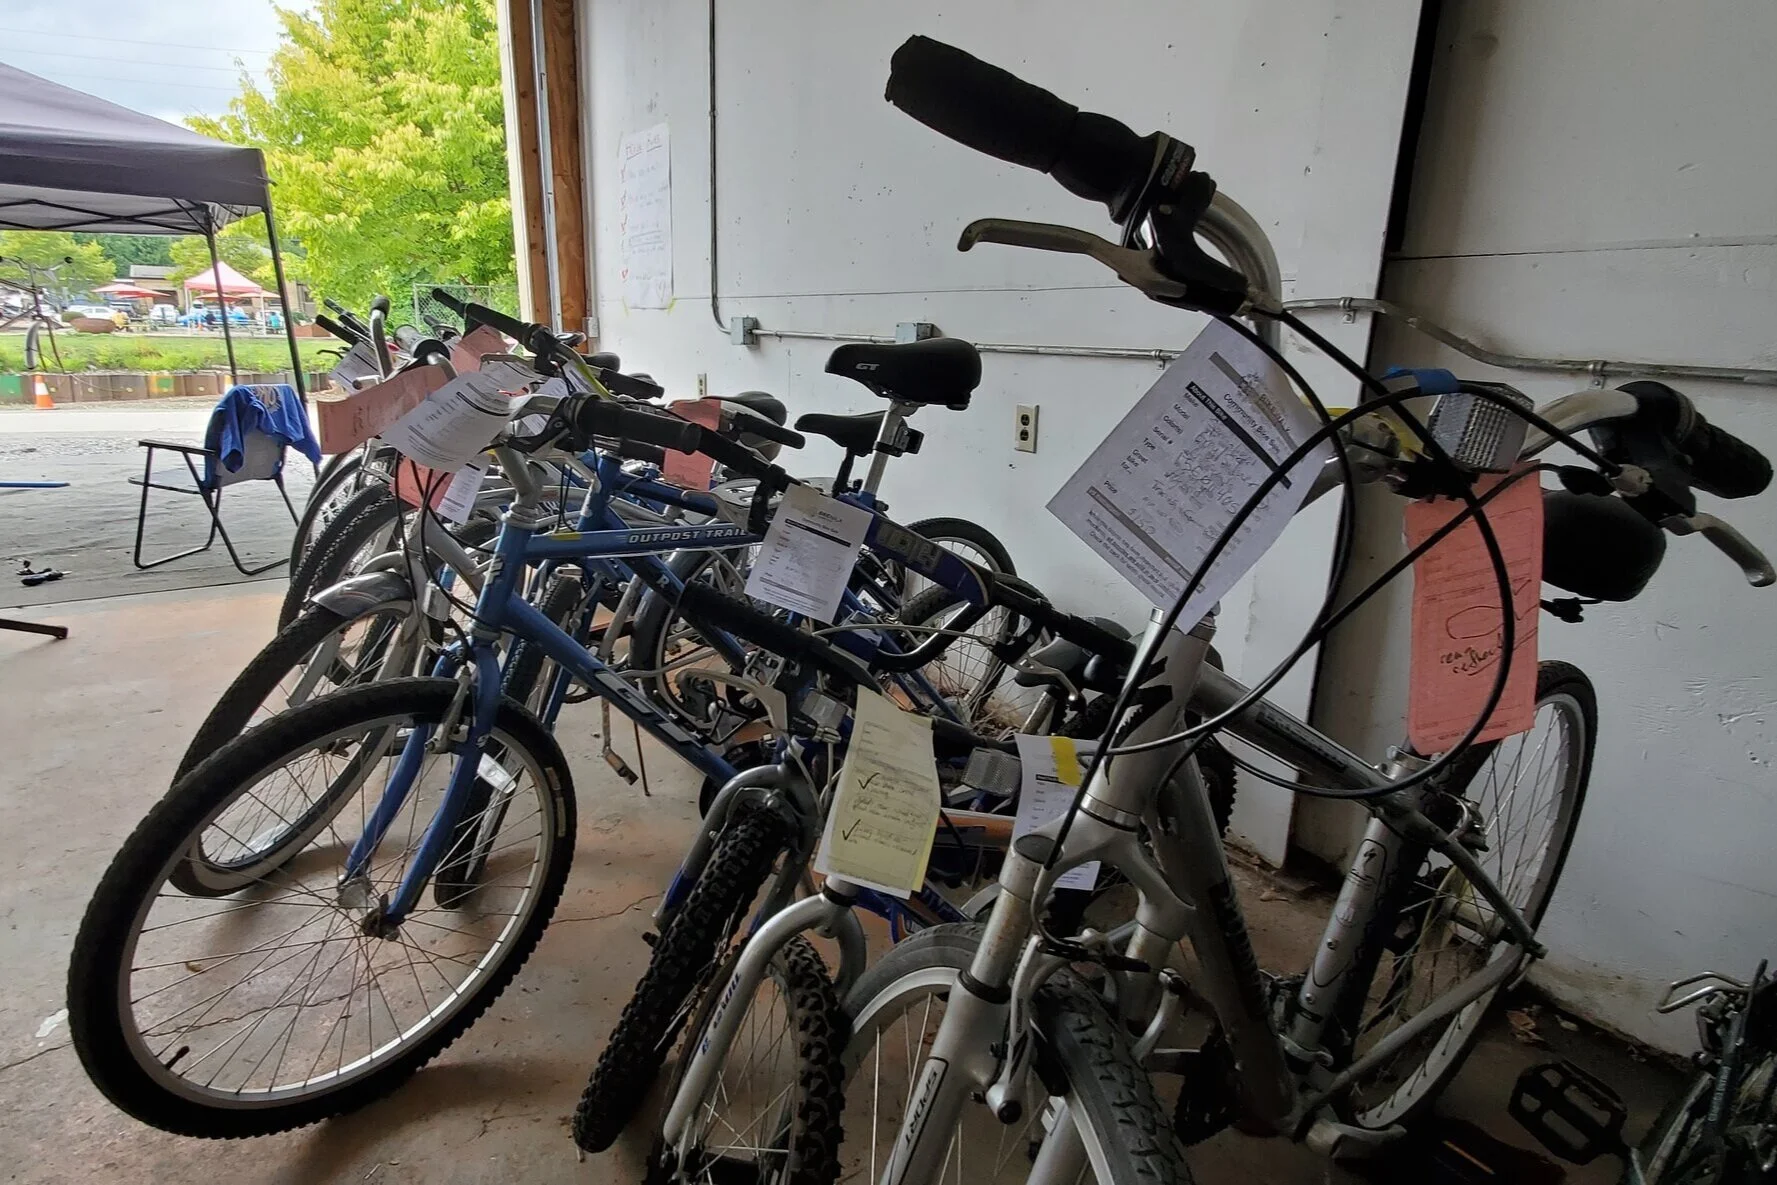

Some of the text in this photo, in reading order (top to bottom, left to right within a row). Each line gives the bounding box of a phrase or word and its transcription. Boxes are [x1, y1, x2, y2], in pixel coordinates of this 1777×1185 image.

[855, 362, 880, 371] GT
[1189, 383, 1227, 421] About This Bike
[1172, 402, 1190, 420] Model
[1222, 391, 1257, 429] Community
[1255, 425, 1271, 442] Bike
[1152, 425, 1169, 442] Serial
[1141, 436, 1156, 451] Type
[1125, 454, 1139, 467] bike
[1131, 447, 1148, 464] Great
[1102, 479, 1118, 494] Price
[628, 528, 747, 543] OUTPOST TRAIL
[905, 1067, 938, 1151] SPORT
